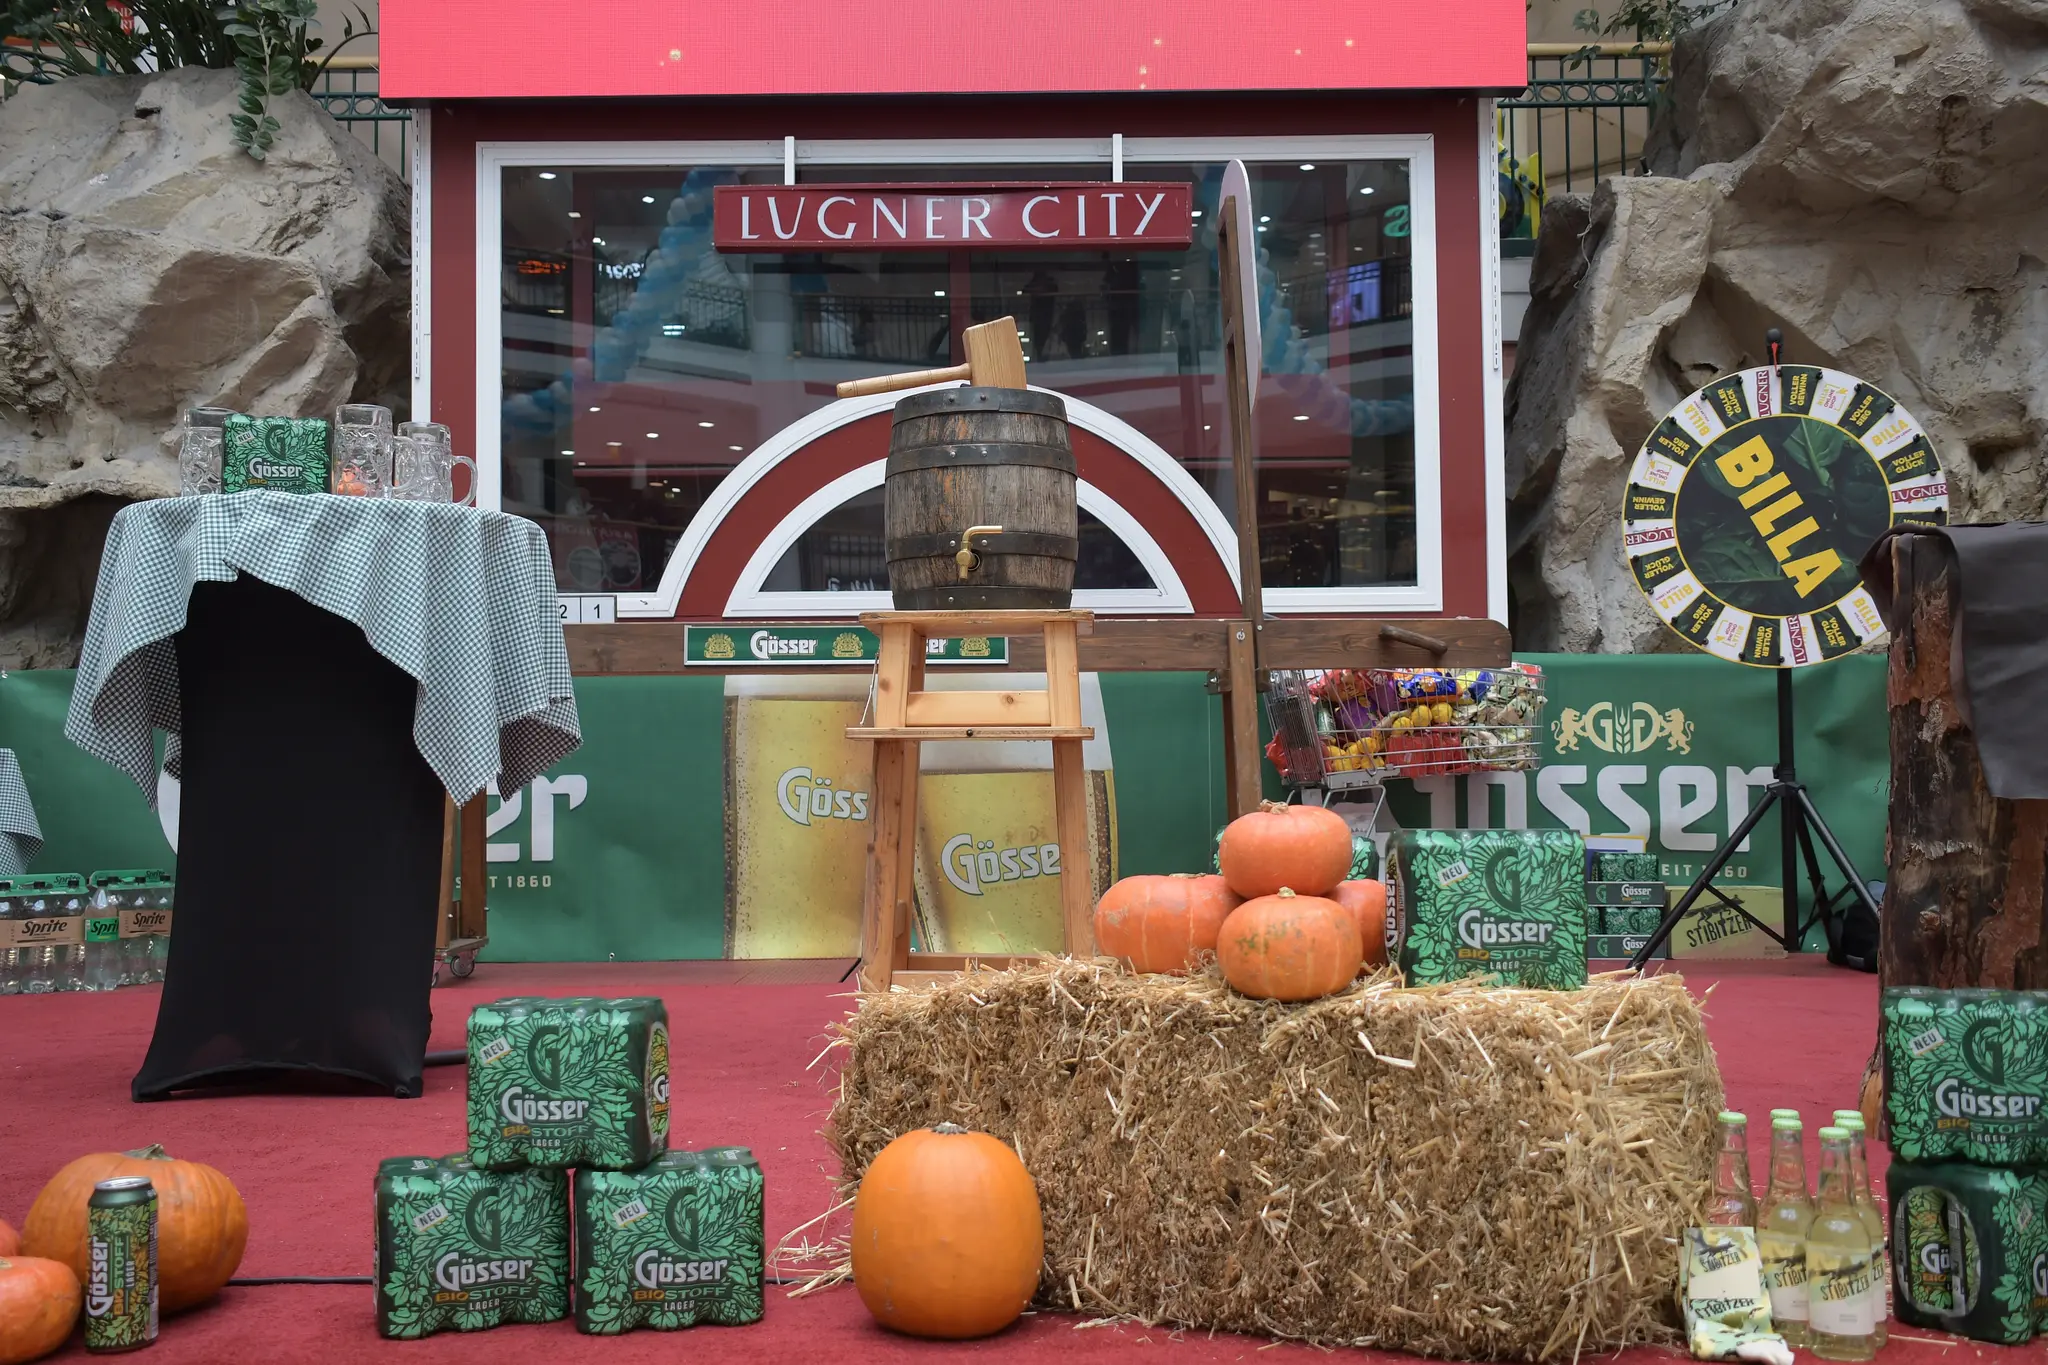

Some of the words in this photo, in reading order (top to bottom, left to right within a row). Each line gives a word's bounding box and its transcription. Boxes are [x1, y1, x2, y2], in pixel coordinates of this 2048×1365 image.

[741, 195, 993, 240] LUGNER
[1022, 193, 1166, 237] CITY
[1757, 370, 1769, 417] LUGNER
[1790, 375, 1800, 405] VOLLER
[1798, 373, 1808, 406] GEWINN
[1717, 388, 1734, 418] VOLLER
[1727, 388, 1742, 414] GLÜCK
[1850, 395, 1874, 422] VOLLER
[1684, 404, 1711, 436] BILLA
[1856, 410, 1872, 427] SIEG
[238, 431, 252, 443] NEU
[1673, 437, 1690, 450] SIEG
[1872, 419, 1909, 447] BILLA
[1658, 436, 1685, 457] VOLLER
[249, 457, 303, 478] Gösser
[1892, 450, 1926, 467] VOLLER
[1895, 459, 1925, 474] GLÜCK
[1633, 496, 1665, 505] GEWINN
[1892, 484, 1948, 501] LUGNER
[1634, 503, 1665, 512] VOLLER
[1715, 434, 1842, 599] BILLA
[1626, 528, 1675, 545] LUGNER
[1644, 564, 1674, 579] VOLLER
[1645, 556, 1671, 569] GLÜCK
[1659, 583, 1694, 609] BILLA
[560, 604, 568, 619] 2
[593, 604, 601, 619] 1
[1691, 608, 1714, 634] VOLLER
[1692, 603, 1708, 620] SIEG
[1853, 597, 1882, 632] BILLA
[1754, 626, 1765, 658] GEWINN
[1762, 627, 1773, 657] VOLLER
[1788, 615, 1806, 662] LUGNER
[1821, 621, 1837, 646] GLÜCK
[1829, 617, 1846, 647] VOLLER
[750, 630, 818, 659] Gösser
[777, 767, 869, 826] Göss
[941, 833, 1062, 895] Gösse
[1441, 866, 1463, 882] NEU
[1661, 864, 1692, 877] EIT
[1702, 865, 1747, 878] 60
[455, 875, 498, 888] ST
[506, 875, 552, 888] 1860
[1621, 884, 1652, 897] Gösser
[22, 919, 68, 936] Sprite
[91, 920, 119, 936] Spri
[133, 912, 166, 927] Sprite
[1458, 909, 1553, 948] Gösser
[1622, 937, 1647, 950] Göss
[1489, 960, 1521, 971] LAGER
[483, 1042, 504, 1060] NEU
[1914, 1033, 1937, 1052] NEU
[502, 1086, 589, 1124] Gösser
[1935, 1078, 2040, 1117] Gösser
[531, 1138, 562, 1147] LAGER
[1970, 1132, 2007, 1143] LAGER
[420, 1206, 442, 1227] NEU
[618, 1203, 641, 1222] NEU
[86, 1236, 115, 1317] Gösser
[125, 1261, 136, 1288] LAGER
[436, 1251, 533, 1292] Gösser
[635, 1249, 728, 1289] Gösser
[1774, 1266, 1808, 1288] STIBIT
[1820, 1274, 1870, 1301] STIBITZER
[469, 1299, 501, 1311] LAGER
[664, 1300, 696, 1311] LAGER
